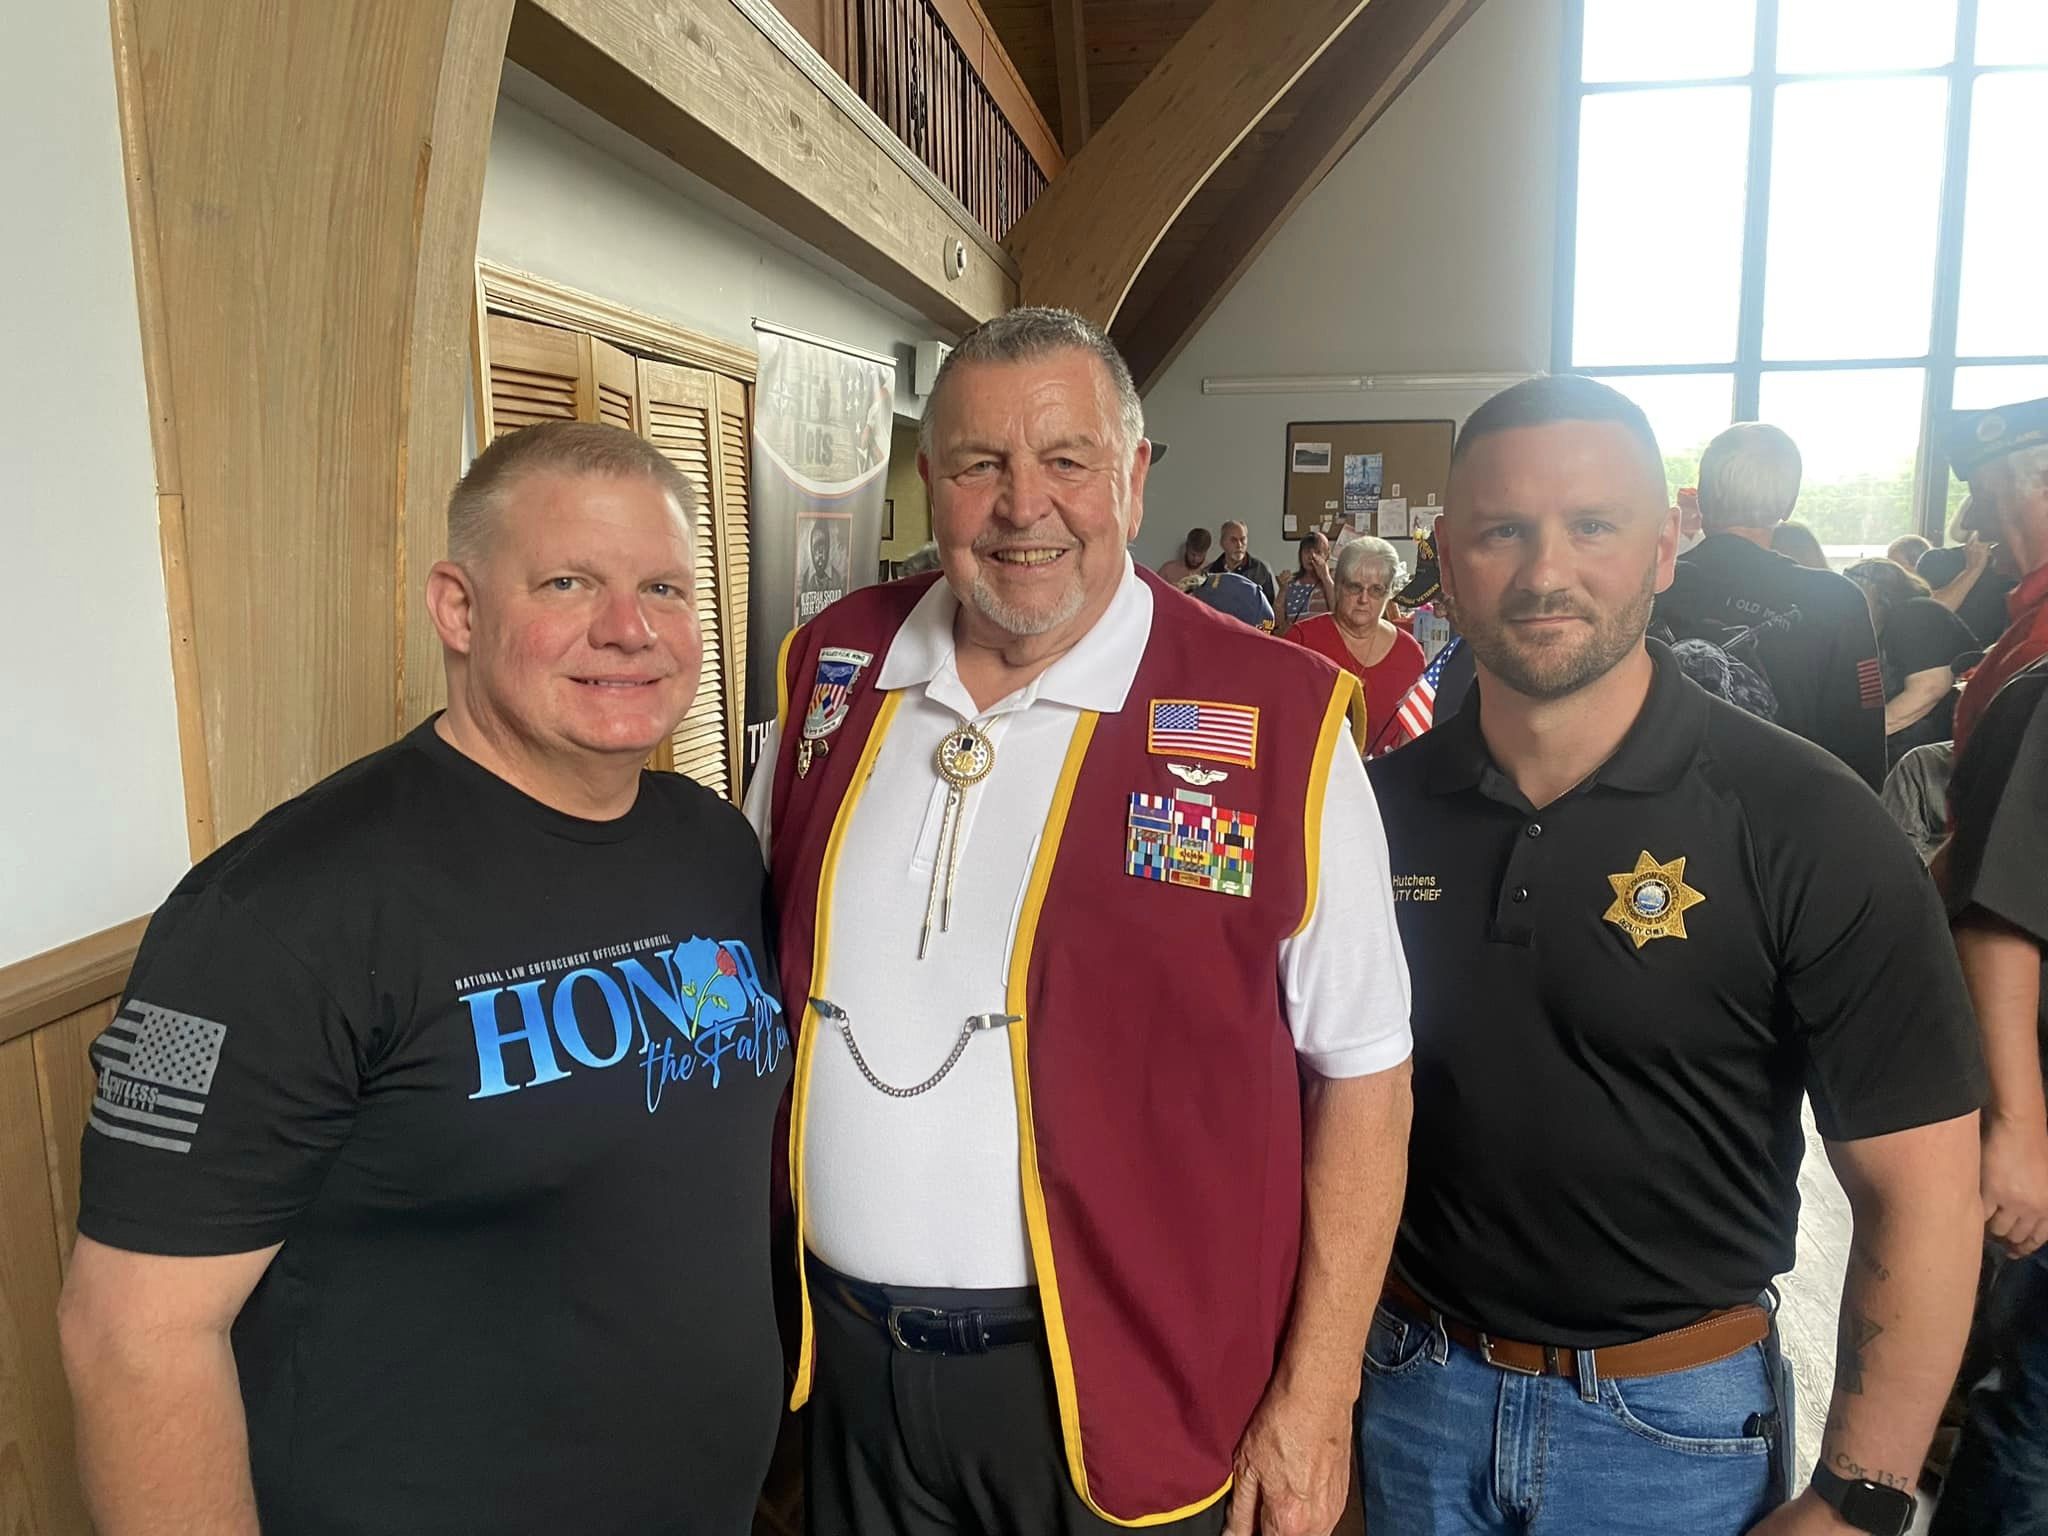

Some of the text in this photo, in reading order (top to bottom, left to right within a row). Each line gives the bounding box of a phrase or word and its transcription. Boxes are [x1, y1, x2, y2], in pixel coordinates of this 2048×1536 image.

[1392, 874, 1436, 887] Hutchens
[1393, 888, 1443, 902] UTY CHIEF
[454, 933, 672, 992] NATIONAL LAW ENFORCEMENT OFFICERS MEMORIAL
[639, 1036, 697, 1114] the
